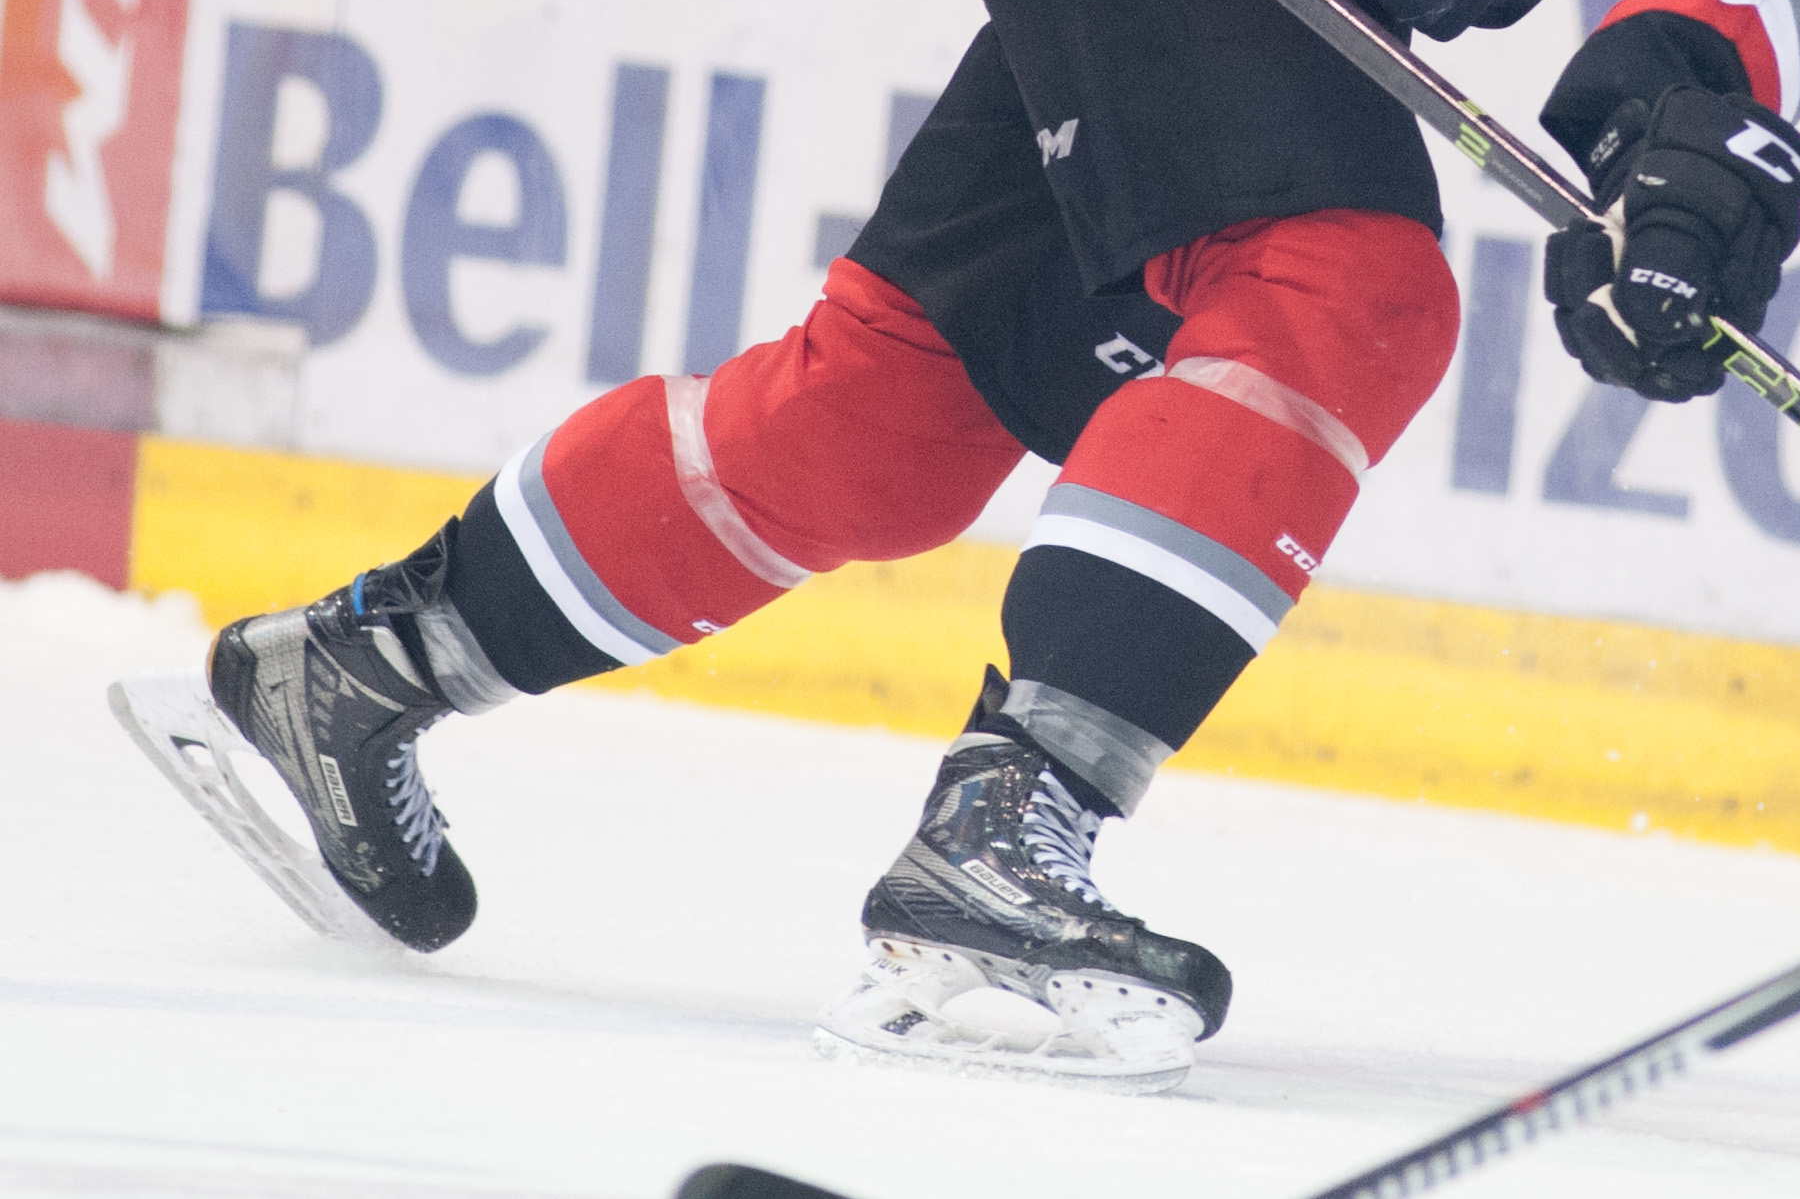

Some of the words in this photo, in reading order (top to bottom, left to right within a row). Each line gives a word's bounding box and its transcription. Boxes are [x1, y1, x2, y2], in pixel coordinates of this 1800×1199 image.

[1630, 267, 1698, 299] CCM
[1275, 532, 1319, 576] CC
[968, 862, 1024, 902] BAUER
